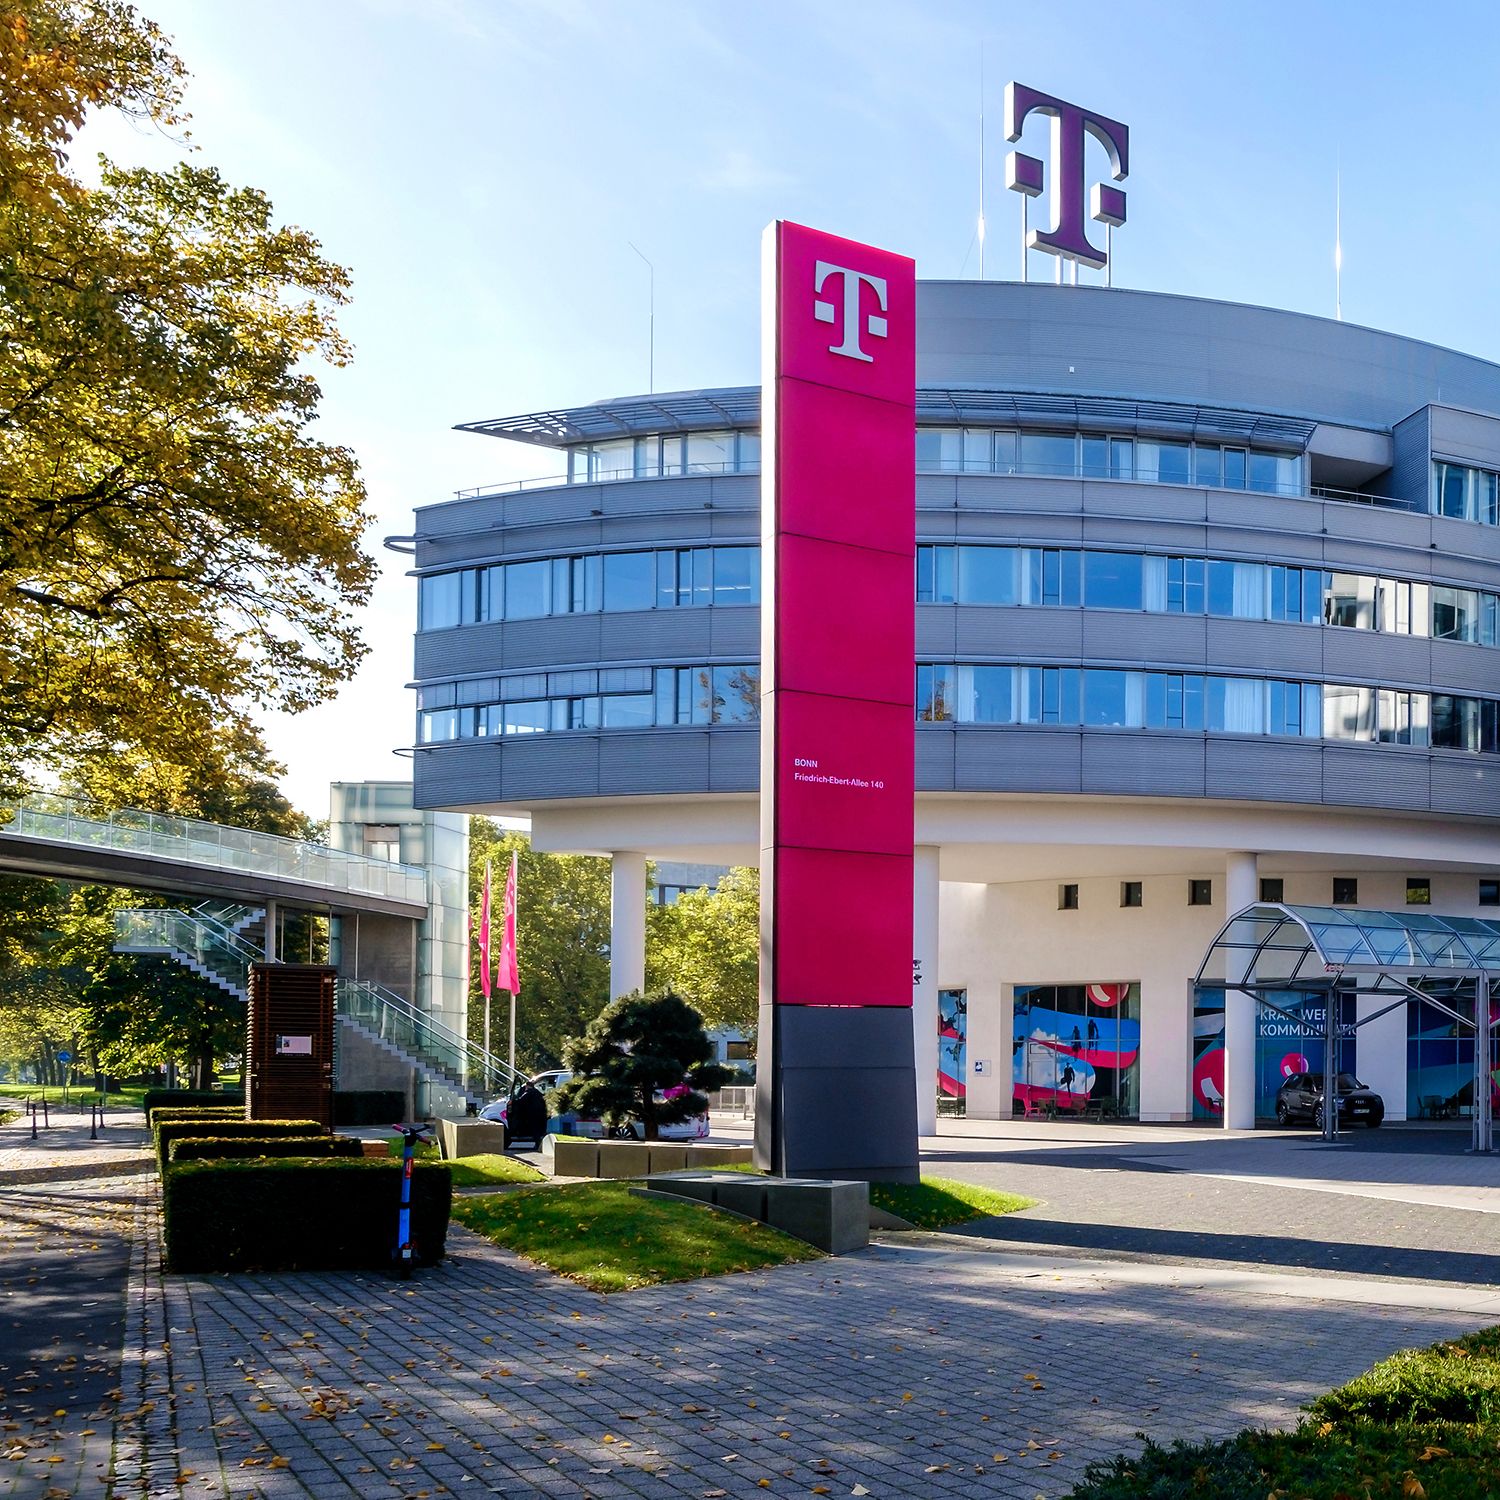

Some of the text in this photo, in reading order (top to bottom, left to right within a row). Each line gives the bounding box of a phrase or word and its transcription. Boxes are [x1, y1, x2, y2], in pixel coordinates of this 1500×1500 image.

[1004, 80, 1129, 270] T
[814, 259, 888, 363] T
[794, 758, 818, 768] BONN
[794, 772, 884, 789] Friedrich-Ebert-Allee 140
